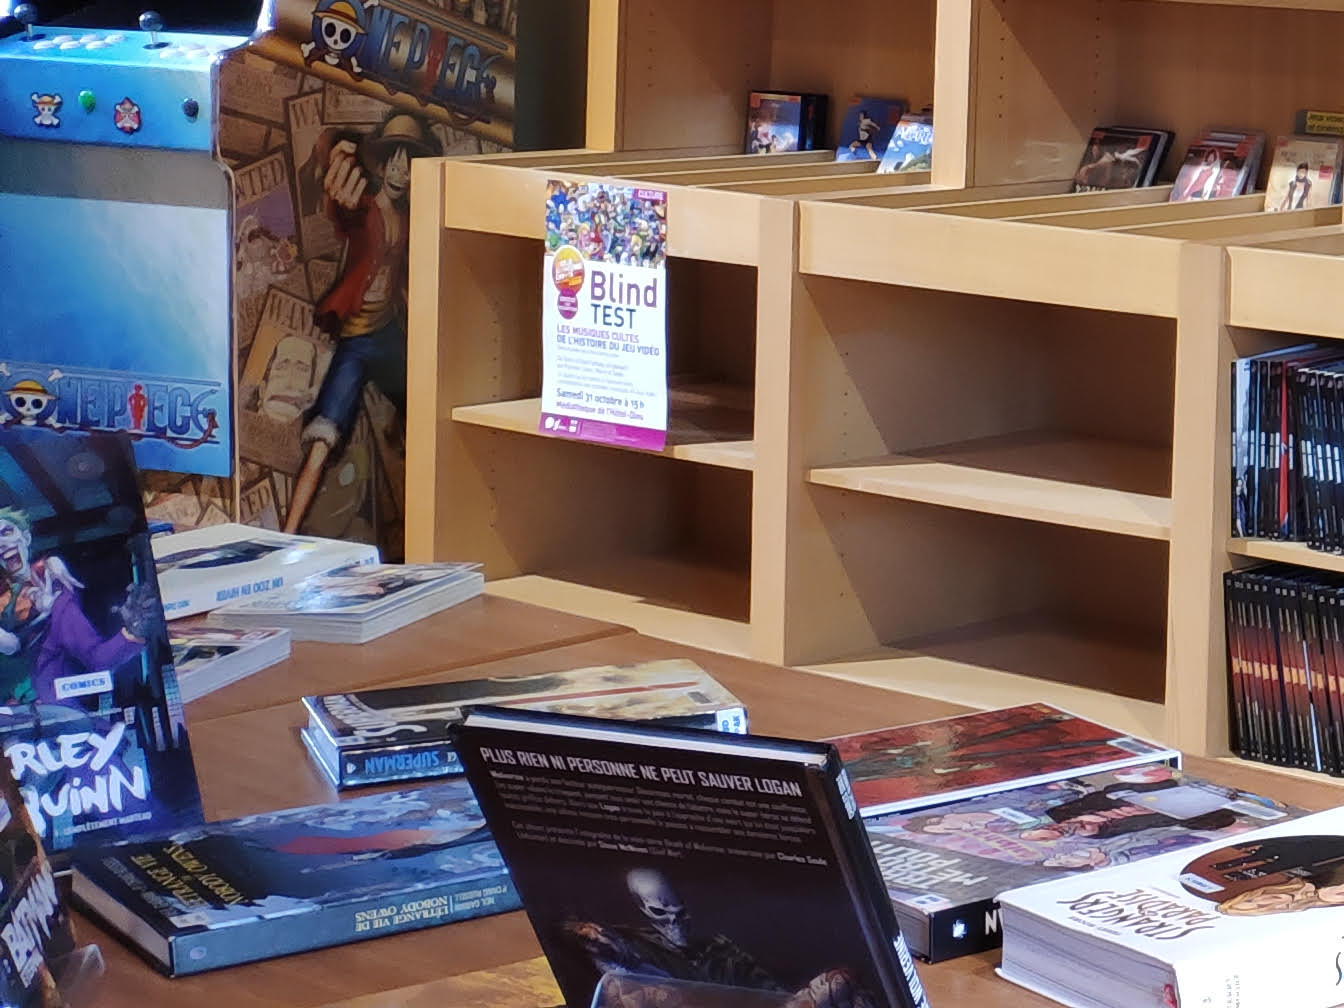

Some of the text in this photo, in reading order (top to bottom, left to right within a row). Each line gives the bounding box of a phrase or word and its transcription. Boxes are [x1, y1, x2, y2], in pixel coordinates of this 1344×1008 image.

[591, 270, 657, 308] Blind
[591, 304, 636, 329] TEST
[557, 325, 639, 343] LES MUSIQUES CULTES
[557, 334, 566, 343] DE
[568, 336, 607, 350] L'HISTOIRE
[609, 342, 620, 351] DU
[621, 343, 636, 353] JEU
[637, 343, 659, 356] VIDÉO
[556, 388, 622, 407] Samedi octobre
[62, 678, 106, 692] COMICS
[364, 750, 441, 776] SUPERMAN
[480, 747, 802, 798] PLUS RIEN NI PERSONNE NE PEUT SAUVER LOGAN
[355, 895, 449, 924] NOBODY OWENS
[1056, 890, 1214, 941] STRANGERS
[1110, 888, 1218, 927] PARADISE
[371, 915, 391, 930] VIE
